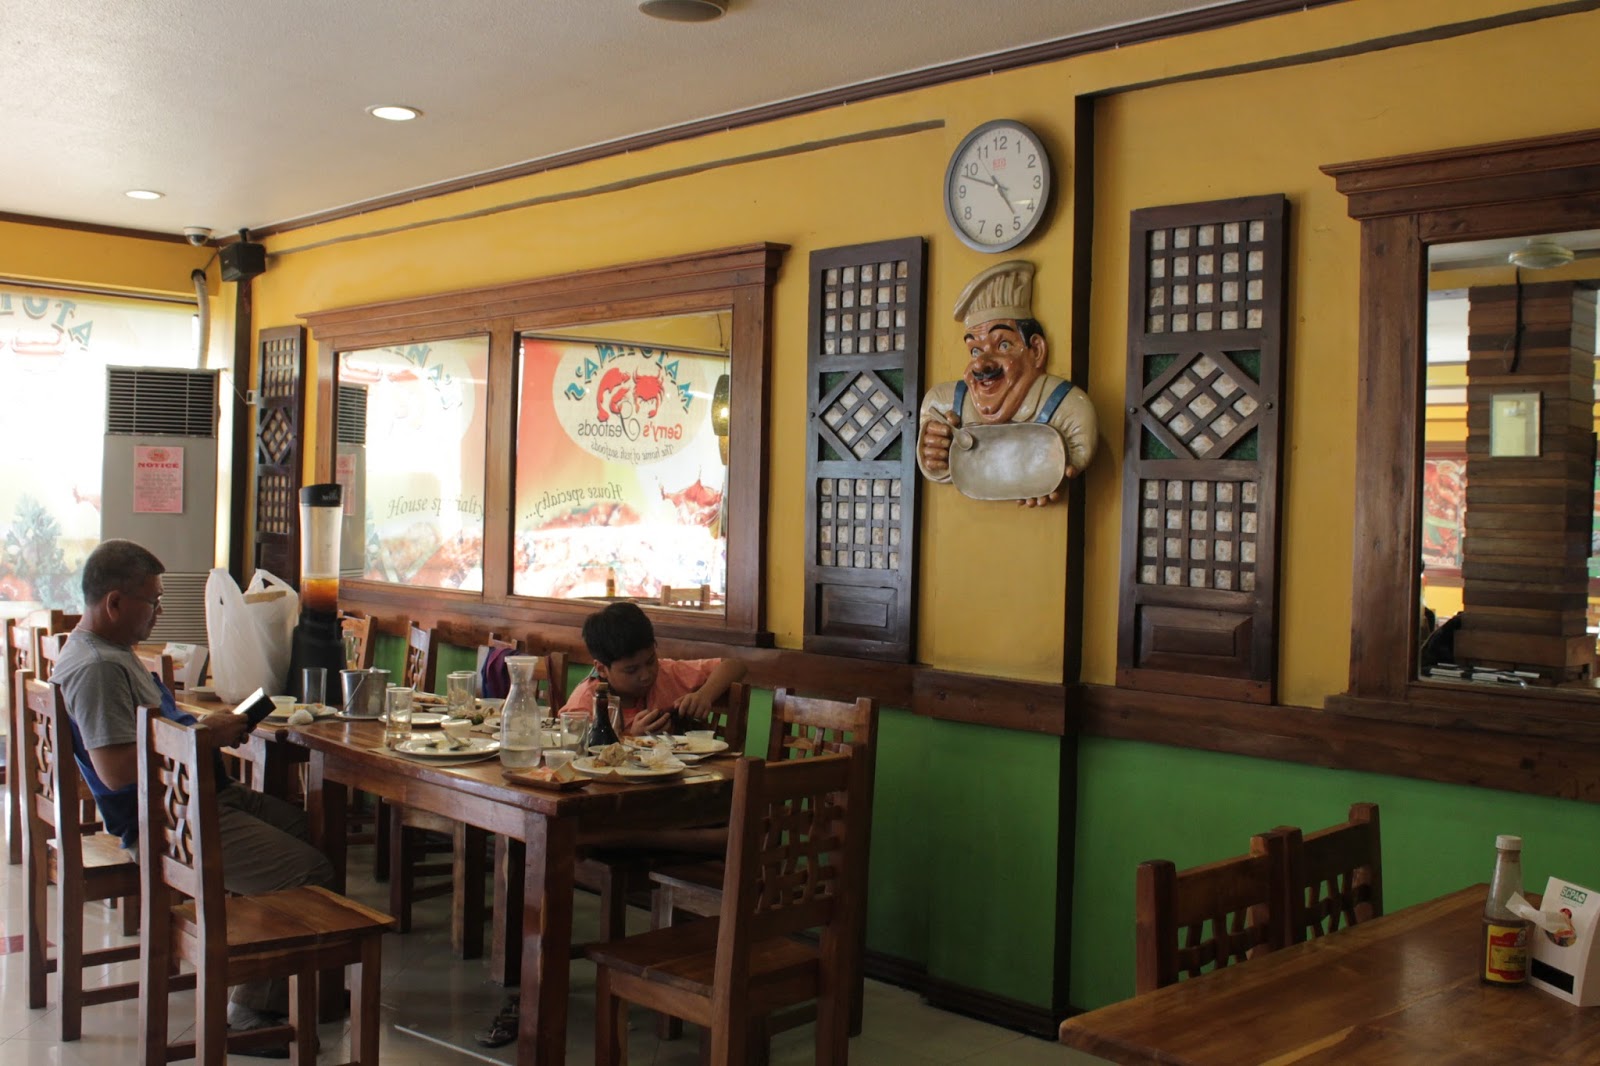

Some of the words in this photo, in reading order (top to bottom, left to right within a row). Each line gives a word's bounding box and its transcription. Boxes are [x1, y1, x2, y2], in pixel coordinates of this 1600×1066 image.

[993, 135, 1008, 151] 12
[1016, 140, 1021, 154] 1
[977, 145, 989, 159] 11
[1027, 154, 1036, 168] 2
[965, 162, 979, 177] 10
[1032, 175, 1041, 189] 3
[959, 185, 967, 199] 9
[1026, 198, 1035, 212] 4
[964, 206, 972, 220] 8
[978, 220, 986, 234] 7
[994, 223, 1003, 238] 6
[1012, 216, 1021, 231] 5
[387, 495, 429, 518] House
